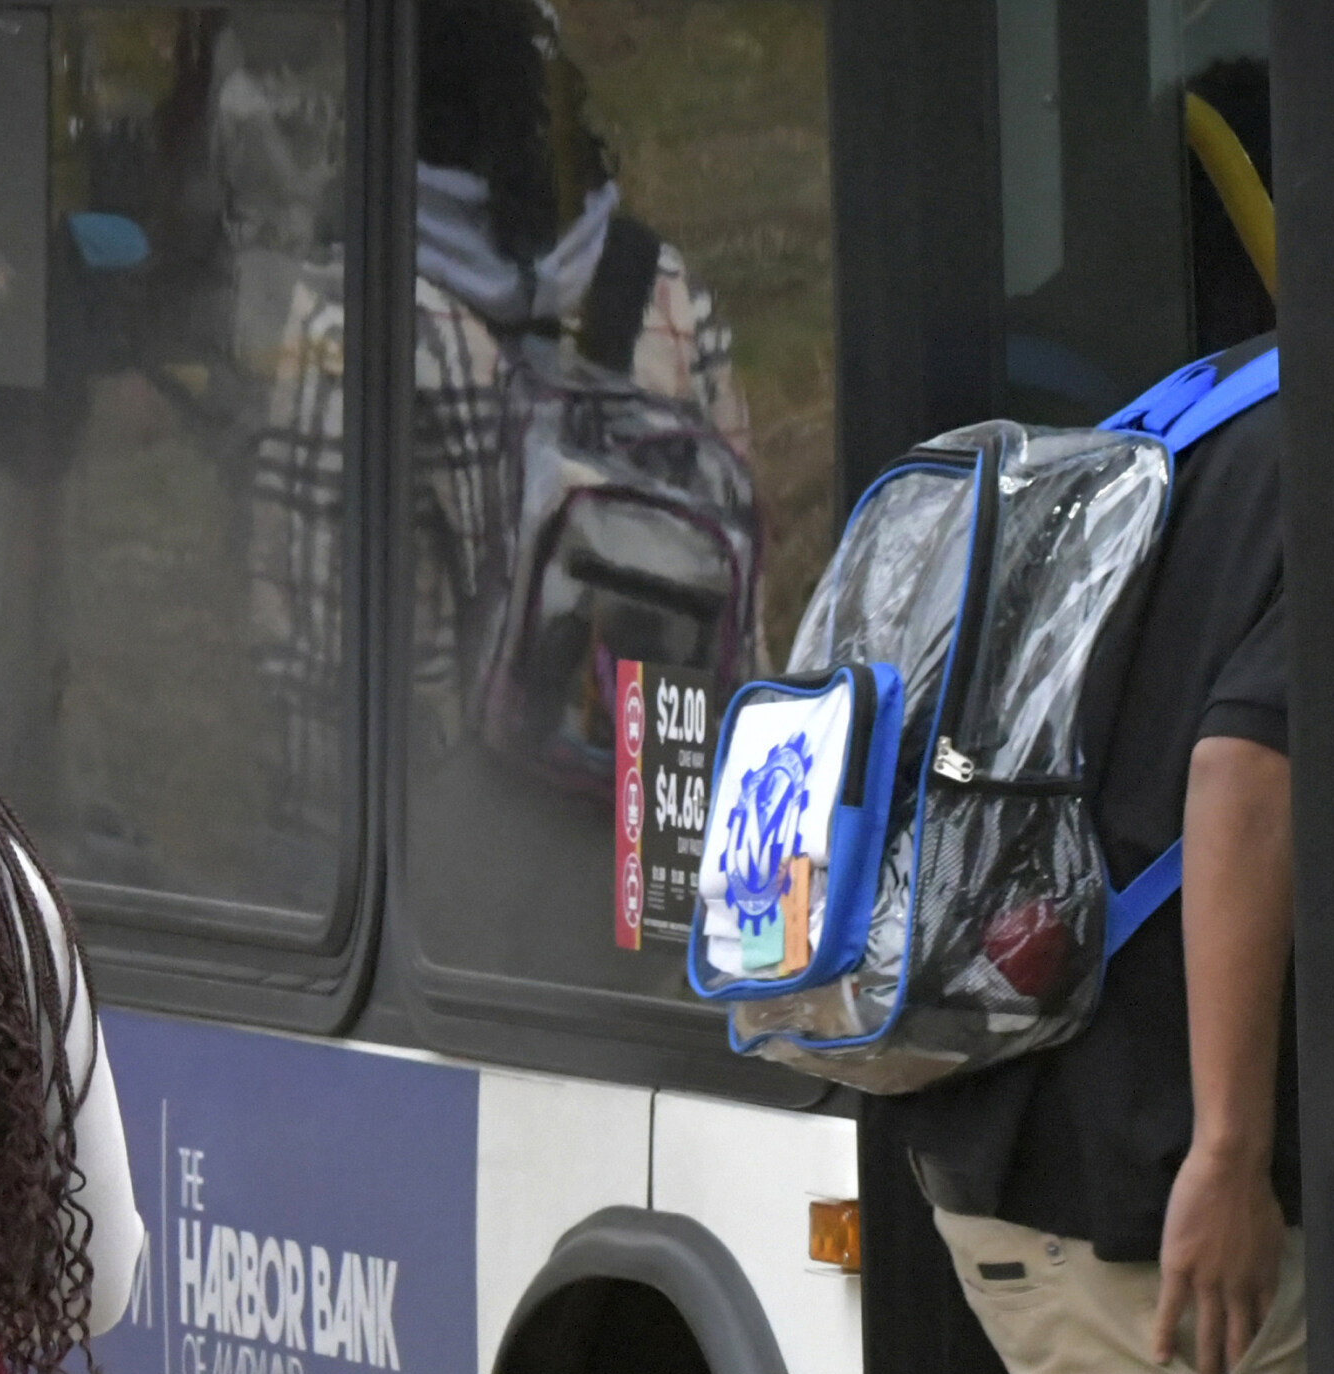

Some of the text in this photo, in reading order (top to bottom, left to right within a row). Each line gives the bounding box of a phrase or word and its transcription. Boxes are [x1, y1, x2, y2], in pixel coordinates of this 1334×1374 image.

[656, 677, 706, 745] $2.00
[179, 1217, 307, 1352] HARBOR
[311, 1245, 401, 1372] BANK
